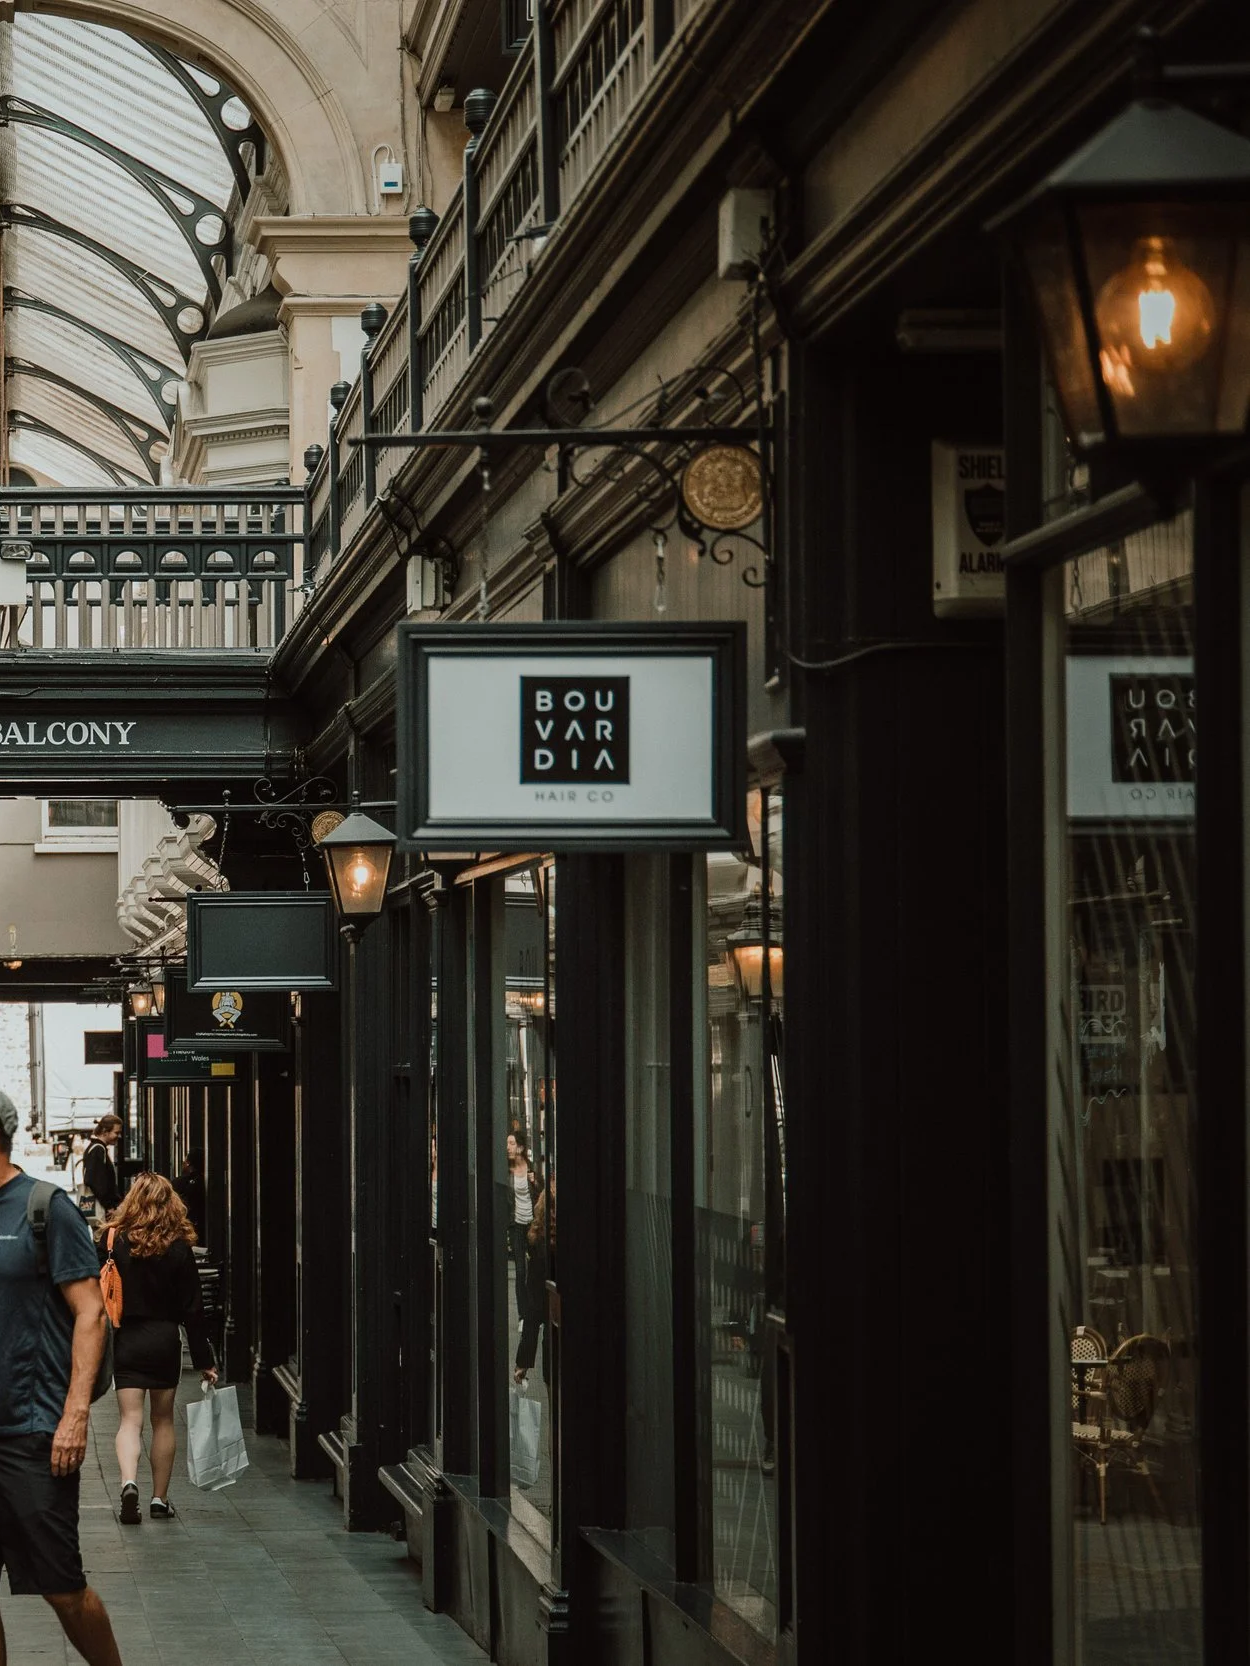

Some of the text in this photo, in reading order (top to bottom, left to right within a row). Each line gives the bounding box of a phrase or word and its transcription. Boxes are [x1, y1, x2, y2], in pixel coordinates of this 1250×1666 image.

[958, 454, 1005, 479] SHIEL
[534, 690, 614, 712] BOU
[534, 719, 613, 741] VAR
[534, 748, 614, 771] DIA
[534, 790, 614, 803] HAIR CO
